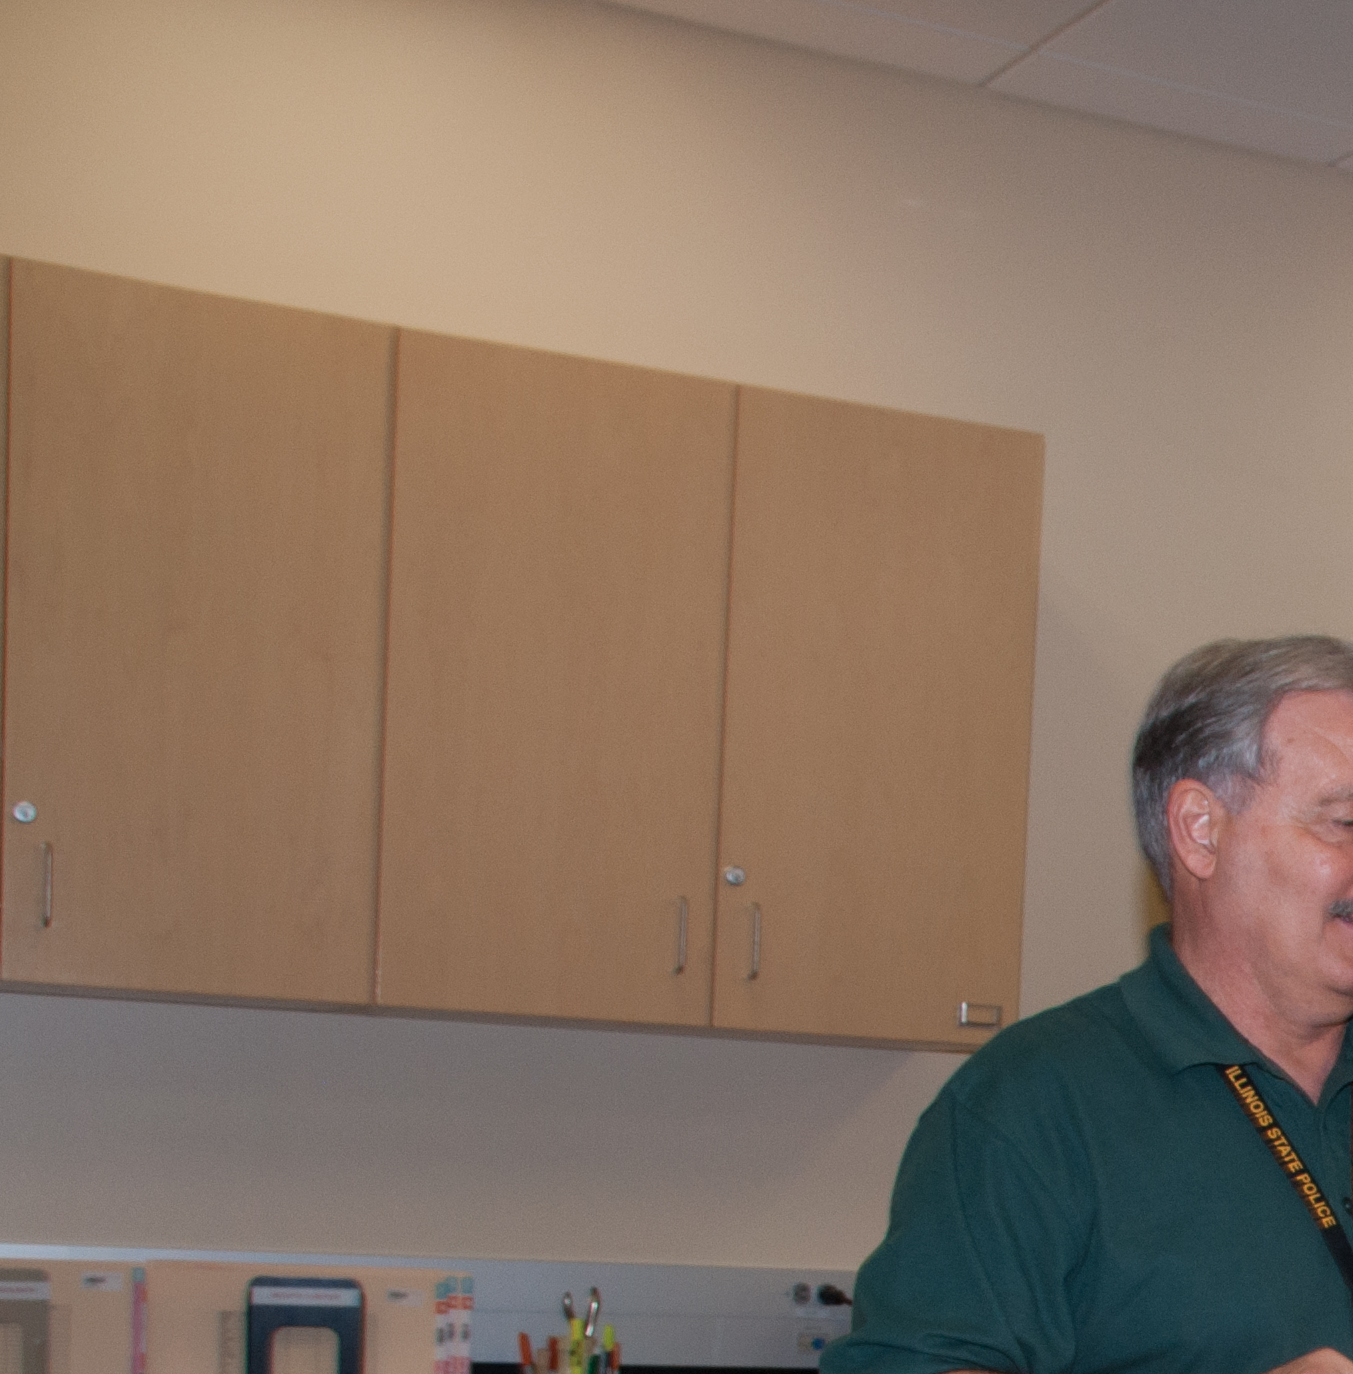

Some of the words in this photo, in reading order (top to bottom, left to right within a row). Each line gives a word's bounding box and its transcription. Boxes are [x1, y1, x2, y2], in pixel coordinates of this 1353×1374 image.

[1225, 1064, 1273, 1127] ILLINOIS
[1267, 1126, 1304, 1173] STATE
[1296, 1173, 1336, 1228] POLICE
